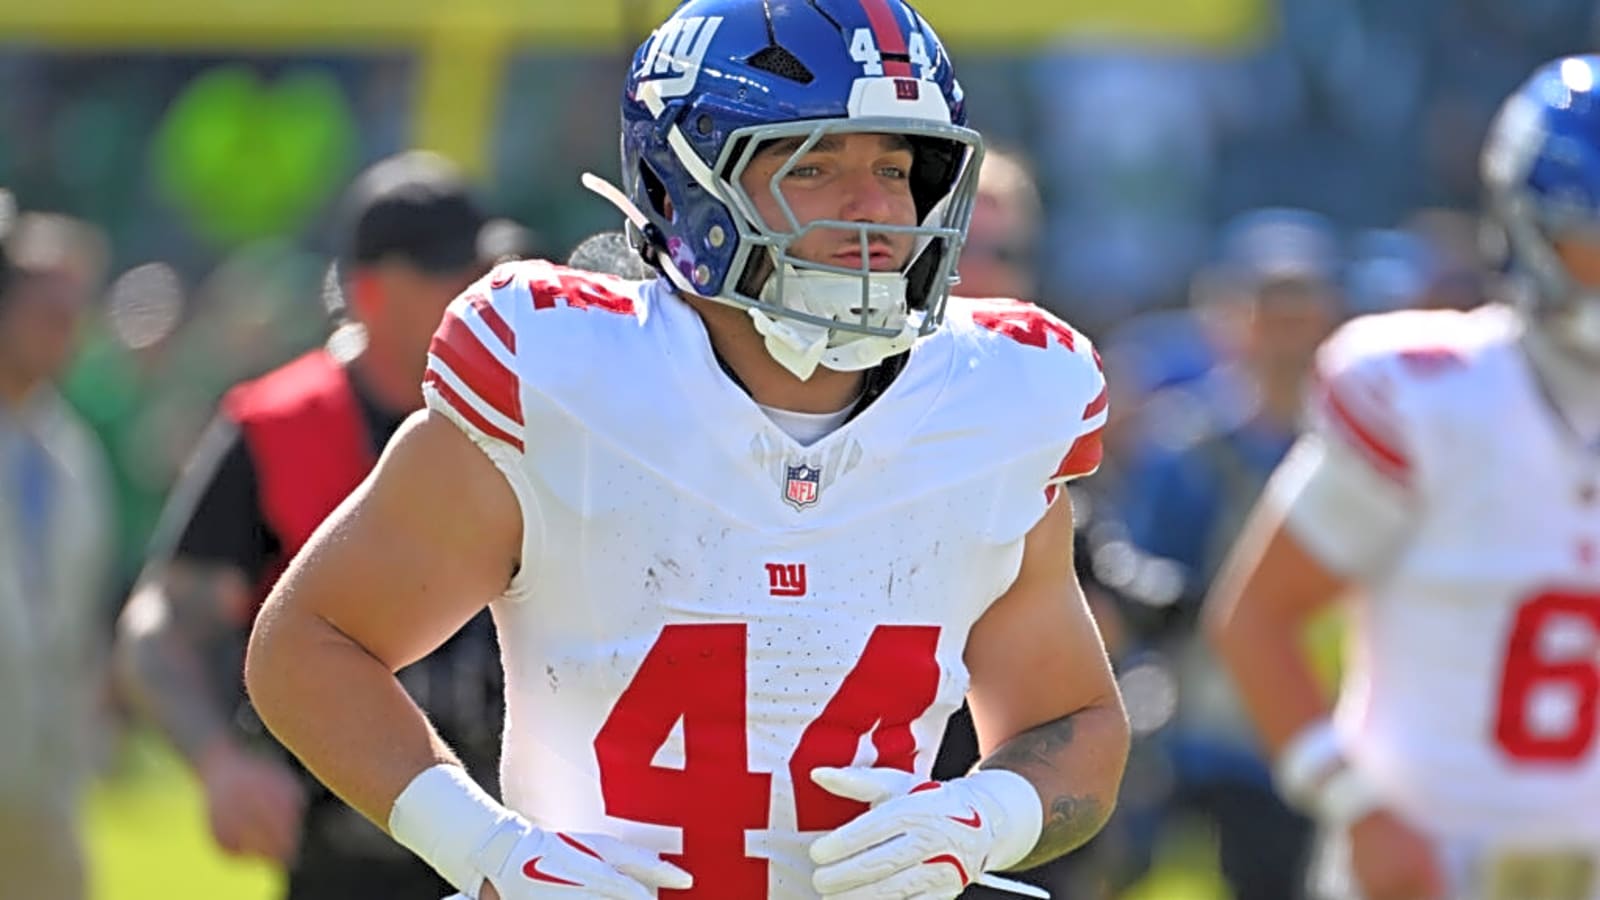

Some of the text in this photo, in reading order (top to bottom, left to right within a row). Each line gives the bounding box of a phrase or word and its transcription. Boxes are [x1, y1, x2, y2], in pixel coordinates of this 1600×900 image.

[788, 481, 815, 502] NFL
[765, 563, 806, 596] ny
[1494, 590, 1600, 762] 6
[594, 623, 942, 900] 44
